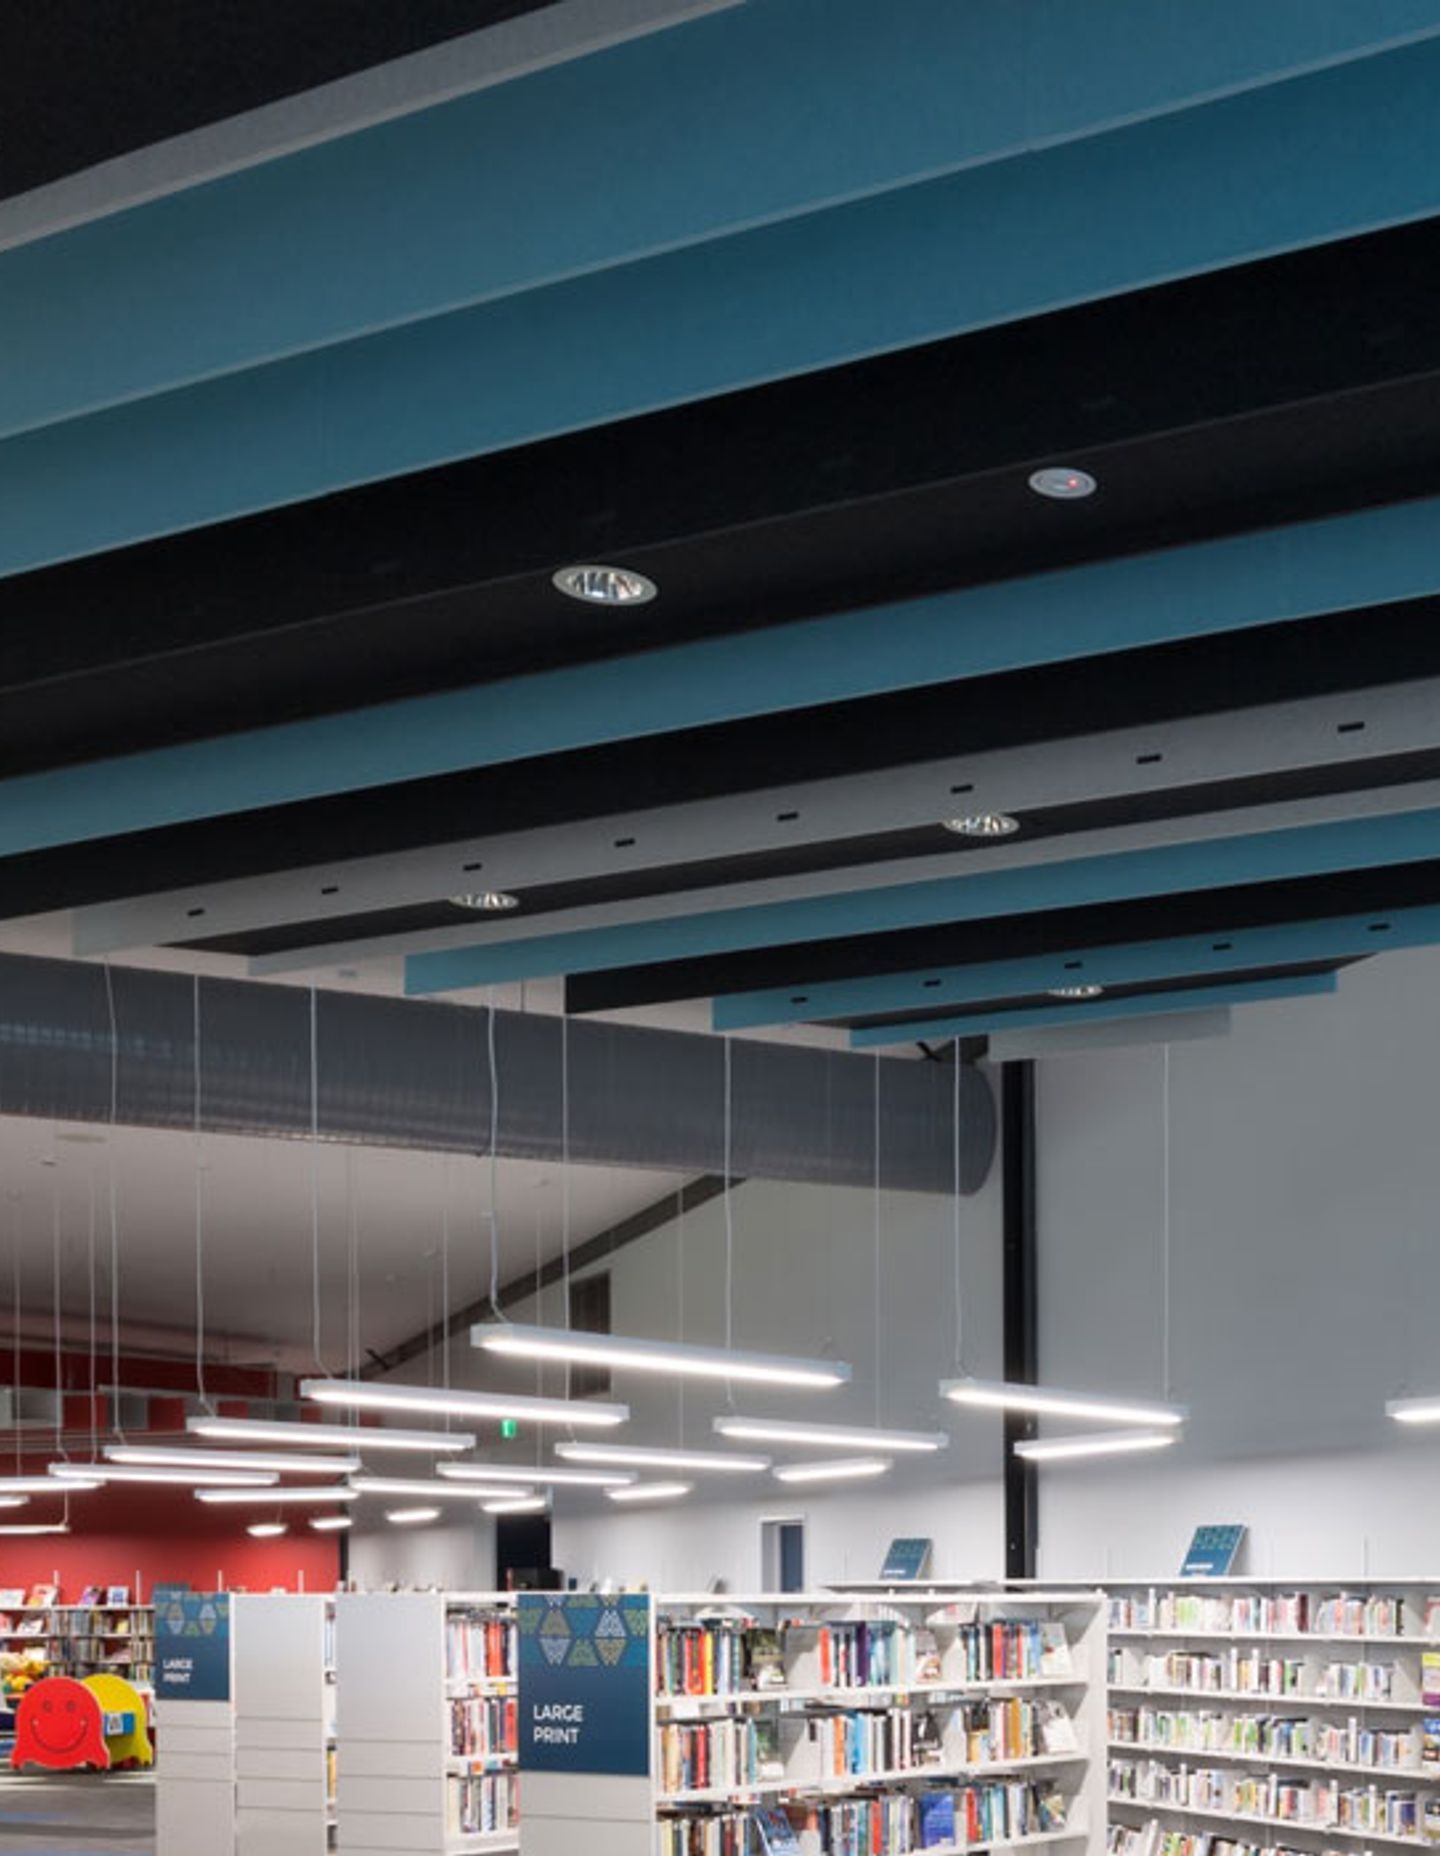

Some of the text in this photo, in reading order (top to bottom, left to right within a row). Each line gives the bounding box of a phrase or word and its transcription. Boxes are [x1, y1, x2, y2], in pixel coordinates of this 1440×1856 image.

[162, 1658, 193, 1669] LARGE
[533, 1704, 584, 1722] LARGE
[533, 1726, 579, 1744] PRINT
